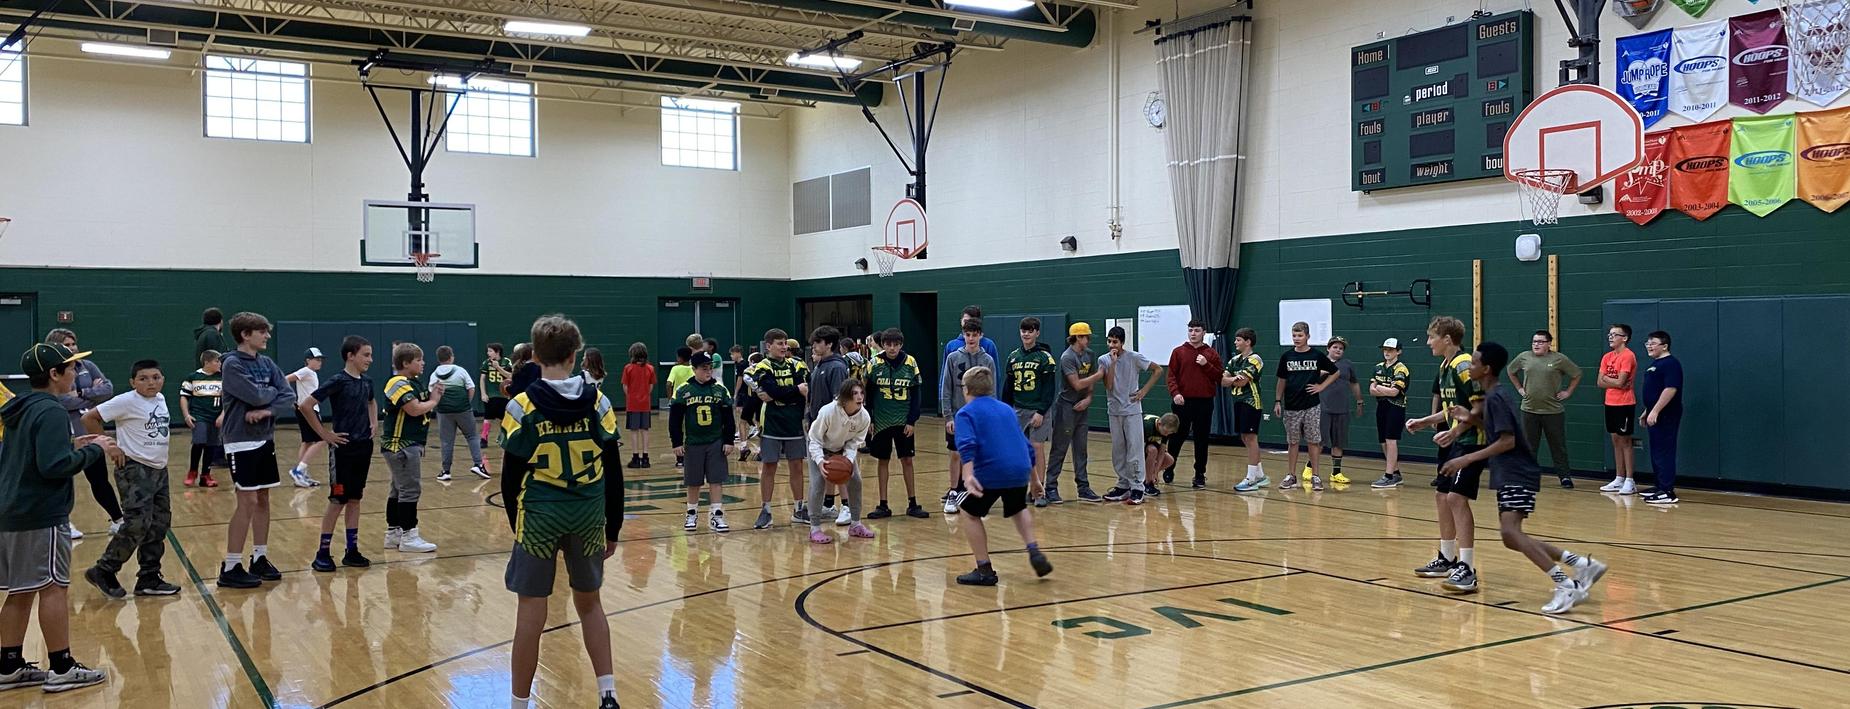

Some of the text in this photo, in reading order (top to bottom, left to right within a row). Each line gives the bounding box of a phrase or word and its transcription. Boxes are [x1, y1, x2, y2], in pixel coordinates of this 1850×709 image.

[1479, 21, 1517, 39] Guests
[1358, 50, 1383, 65] Home
[1743, 48, 1784, 63] HOOPS
[1622, 62, 1668, 84] JUMP ROPE
[1683, 59, 1720, 72] HOOPS
[1416, 81, 1448, 102] period
[1744, 93, 1781, 105] 2011-2012
[1485, 101, 1510, 116] fouls
[1683, 102, 1717, 112] 2010-2011
[1416, 111, 1449, 128] player
[1360, 121, 1382, 136] fouls
[1486, 157, 1503, 170] bou
[1686, 159, 1724, 170] HOOPS
[1745, 153, 1787, 165] HOOPS
[1416, 162, 1449, 177] weight
[1362, 171, 1381, 184] bout
[1684, 202, 1720, 212] 2003-2004
[1287, 360, 1318, 369] COAL CITY
[489, 371, 503, 383] 55
[894, 378, 911, 387] CITY
[1014, 370, 1036, 391] 23
[696, 405, 713, 426] 0
[535, 418, 590, 437] KENNEY
[528, 438, 604, 489] 25
[1052, 598, 1296, 640] IVC
